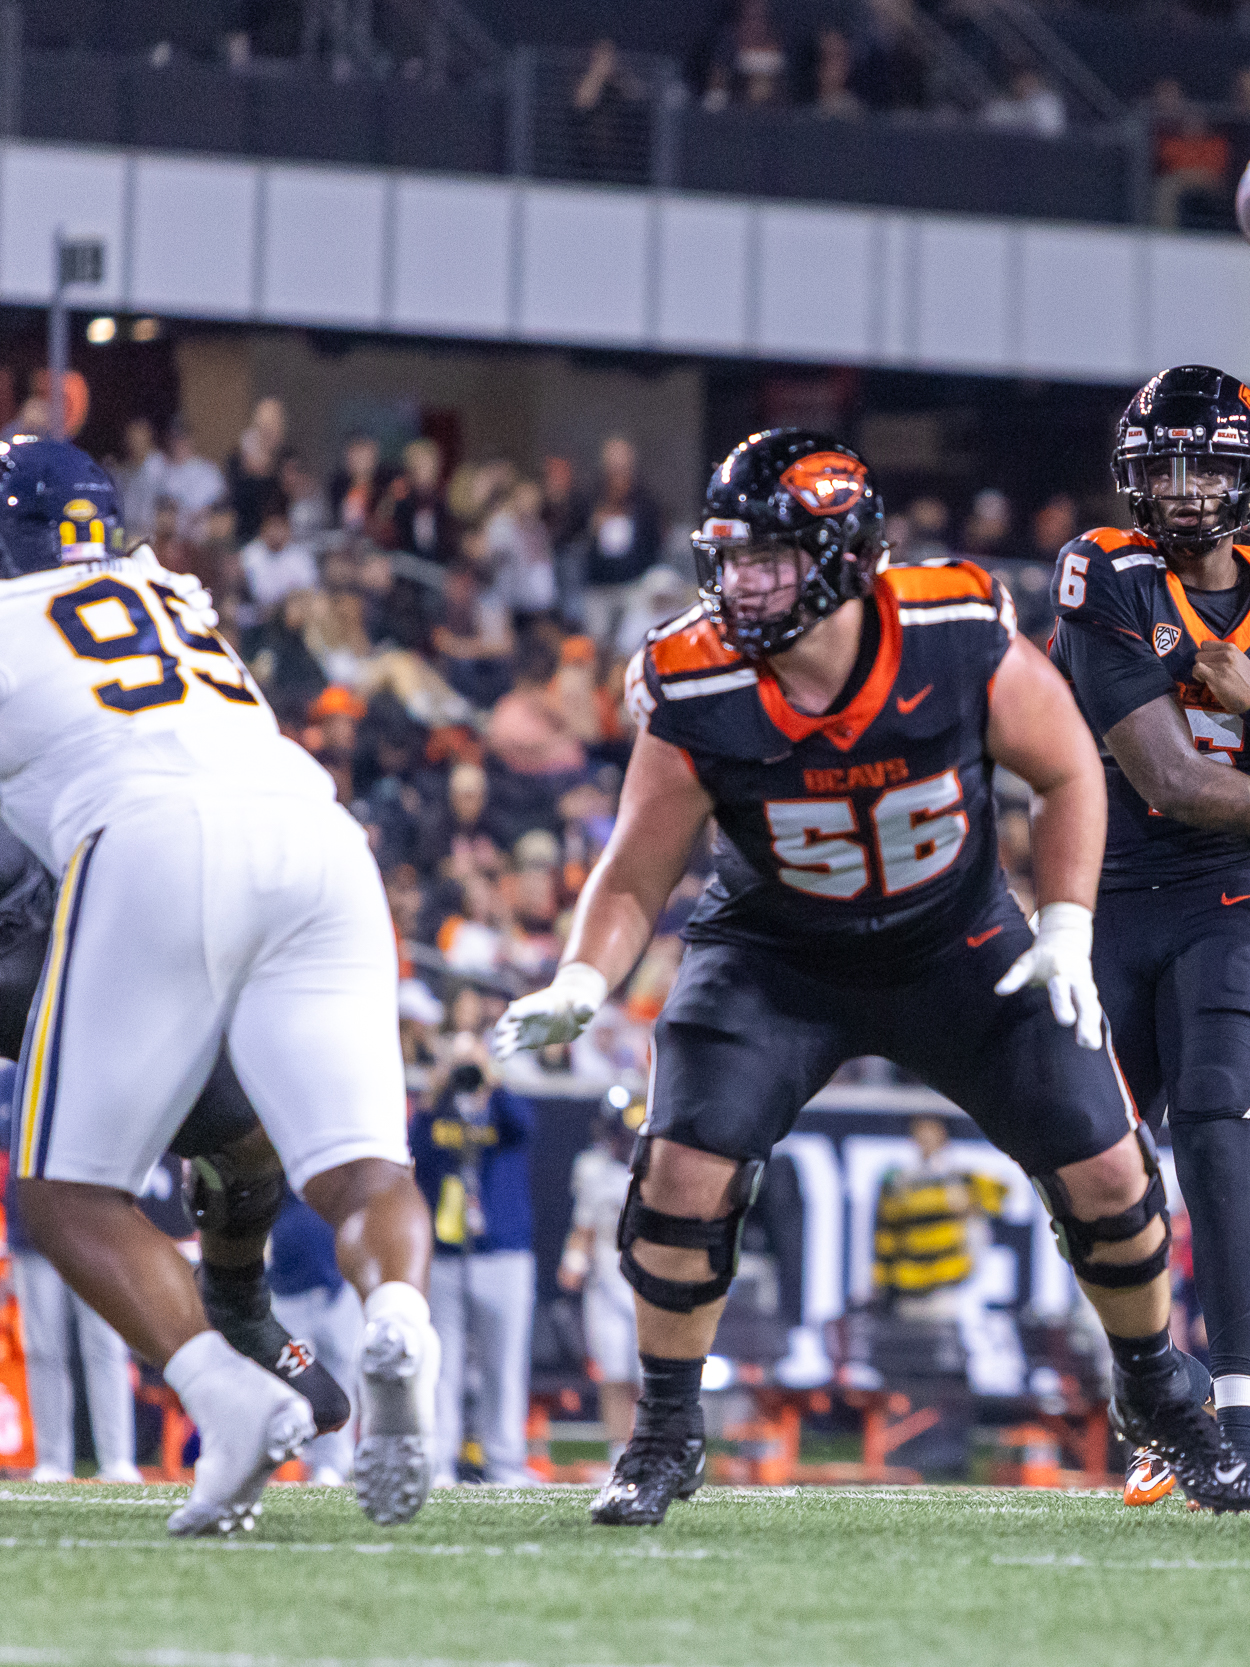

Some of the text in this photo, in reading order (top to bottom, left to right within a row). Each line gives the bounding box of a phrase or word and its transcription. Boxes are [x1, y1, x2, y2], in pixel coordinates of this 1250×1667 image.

[1059, 552, 1090, 609] 6
[1155, 626, 1179, 646] PAC
[1157, 638, 1170, 651] 12
[802, 757, 910, 792] BEAVS
[763, 765, 970, 901] 56
